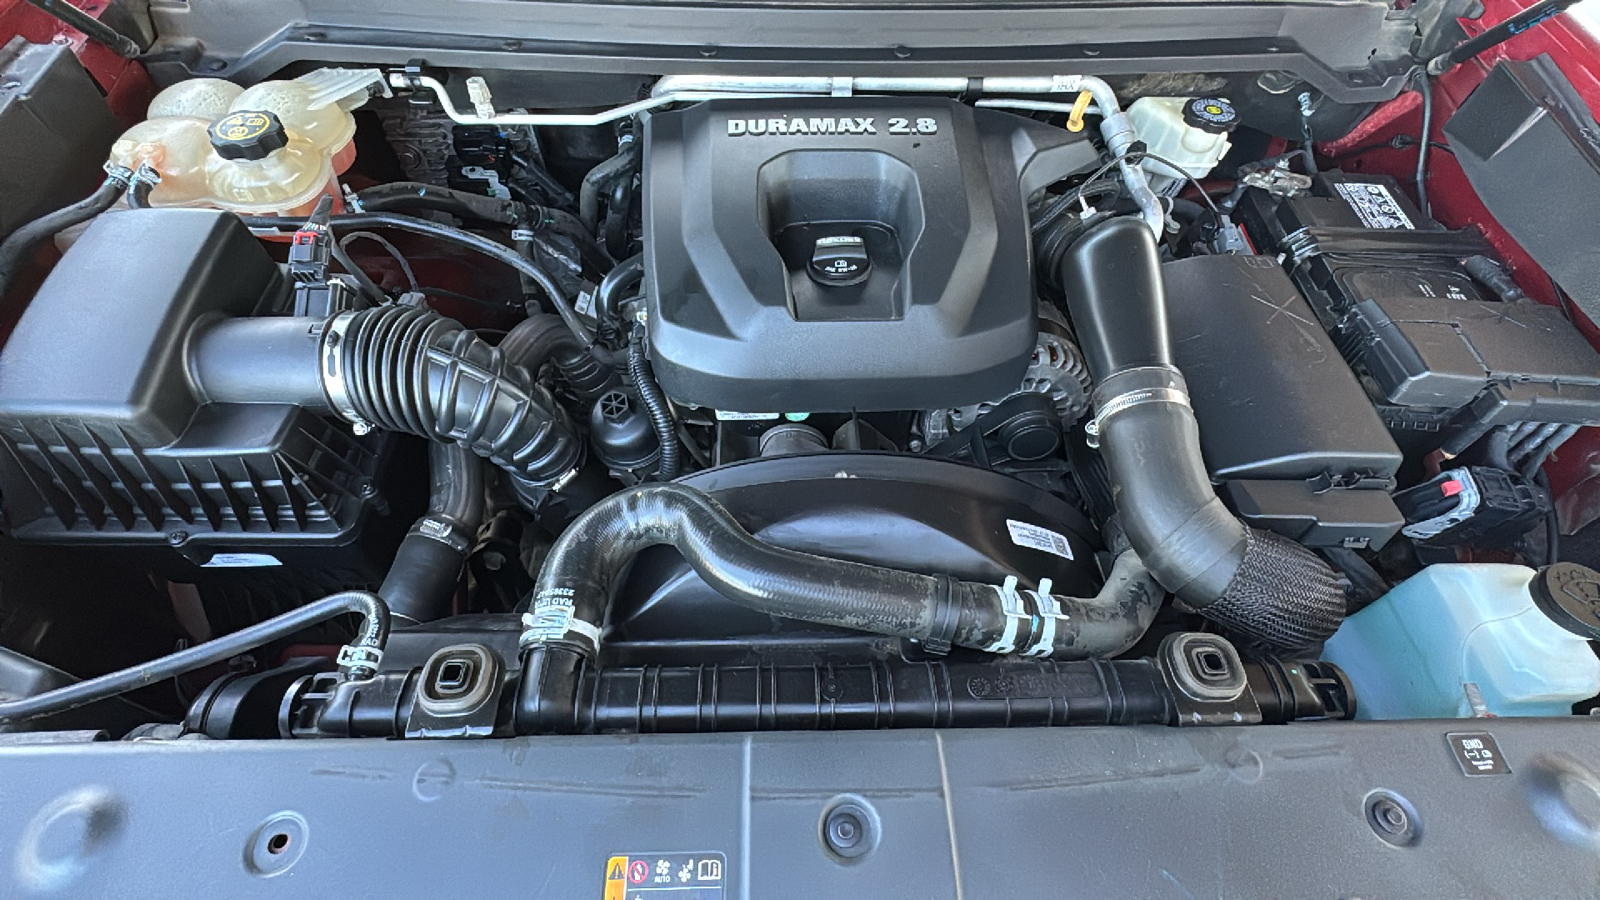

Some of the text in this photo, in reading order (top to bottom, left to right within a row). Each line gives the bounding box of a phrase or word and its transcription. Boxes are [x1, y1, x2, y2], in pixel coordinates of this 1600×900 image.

[727, 117, 939, 136] DURAMAX 2.8
[552, 597, 574, 607] RAD
[654, 875, 671, 883] AUTO
